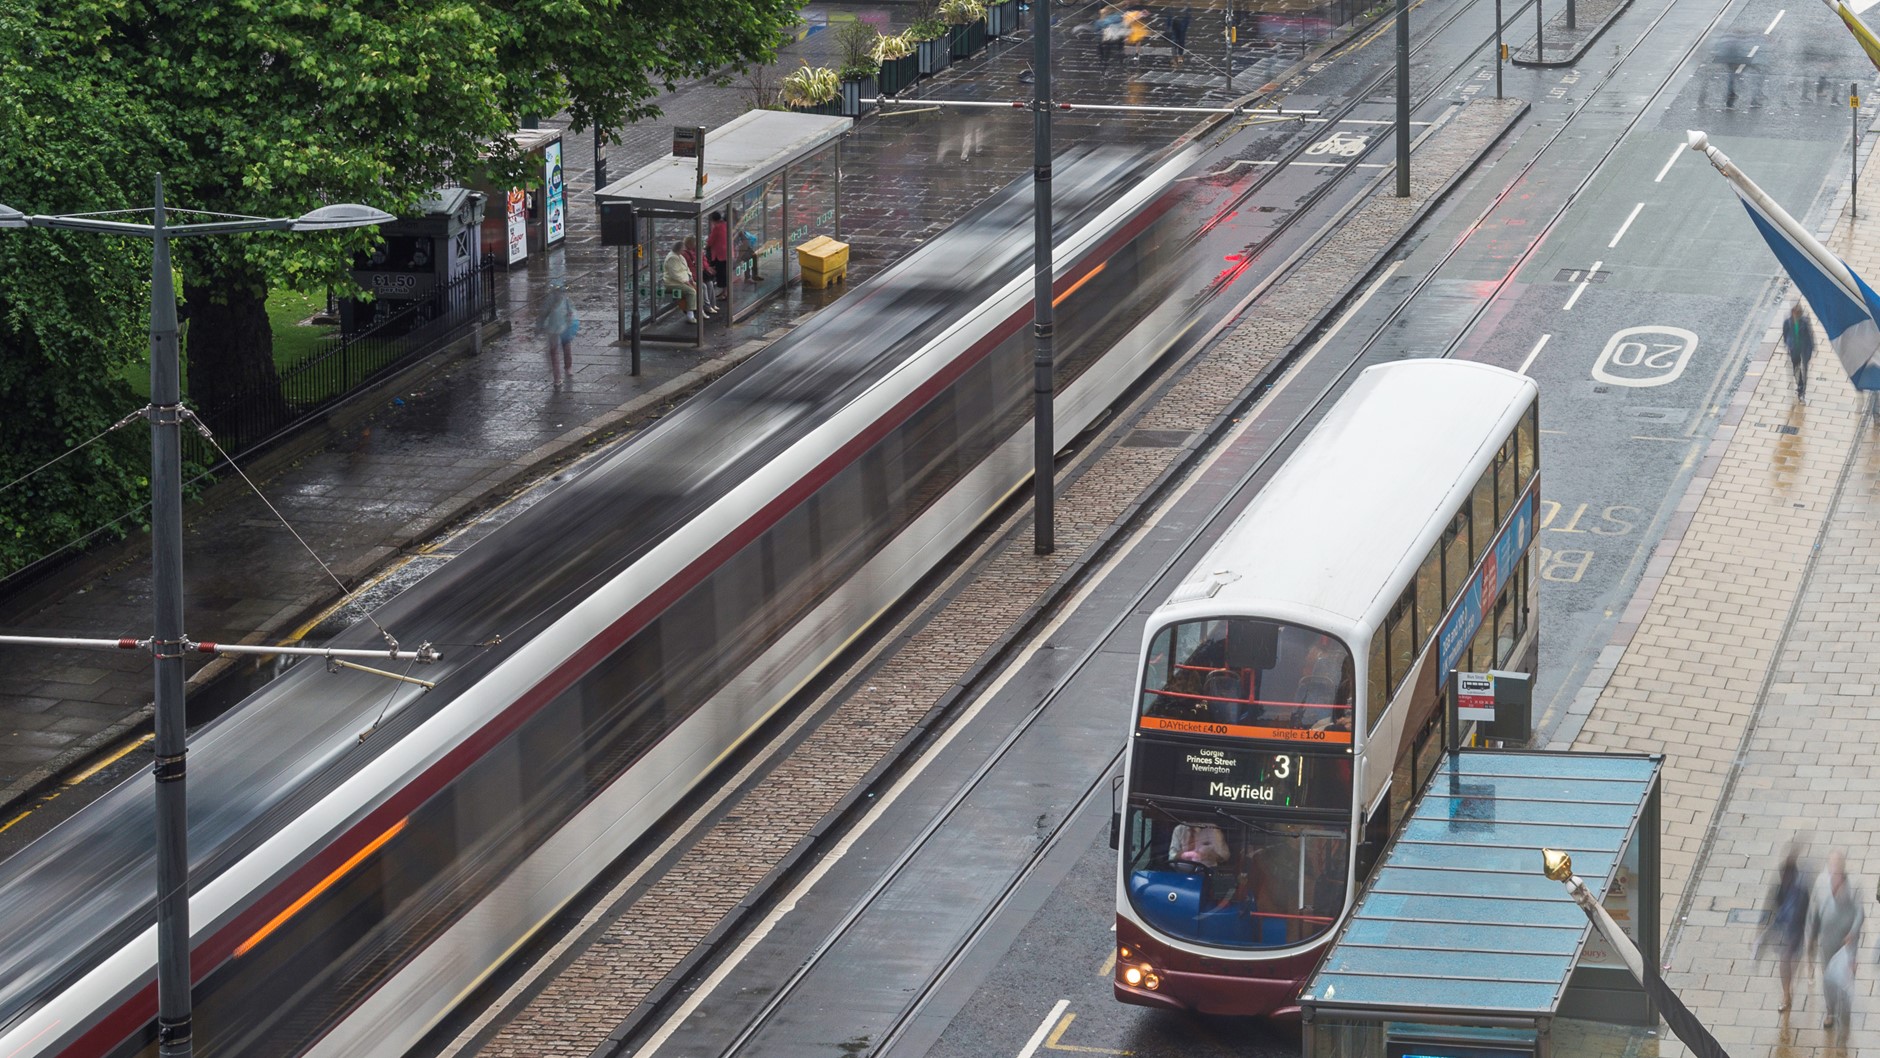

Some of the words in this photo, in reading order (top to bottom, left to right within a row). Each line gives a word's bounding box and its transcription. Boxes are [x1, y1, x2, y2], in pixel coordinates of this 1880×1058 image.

[373, 274, 416, 288] £1.50
[1613, 342, 1682, 368] 20
[1160, 720, 1201, 732] DAYticket
[1203, 724, 1228, 734] £4.00
[1272, 729, 1298, 739] single
[1300, 731, 1325, 740] £1.60
[1200, 748, 1225, 758] Gorgie
[1187, 755, 1212, 765] Princes
[1213, 757, 1237, 767] Street
[1274, 754, 1290, 779] 3
[1192, 763, 1231, 774] Newington
[1209, 781, 1274, 801] Mayfield
